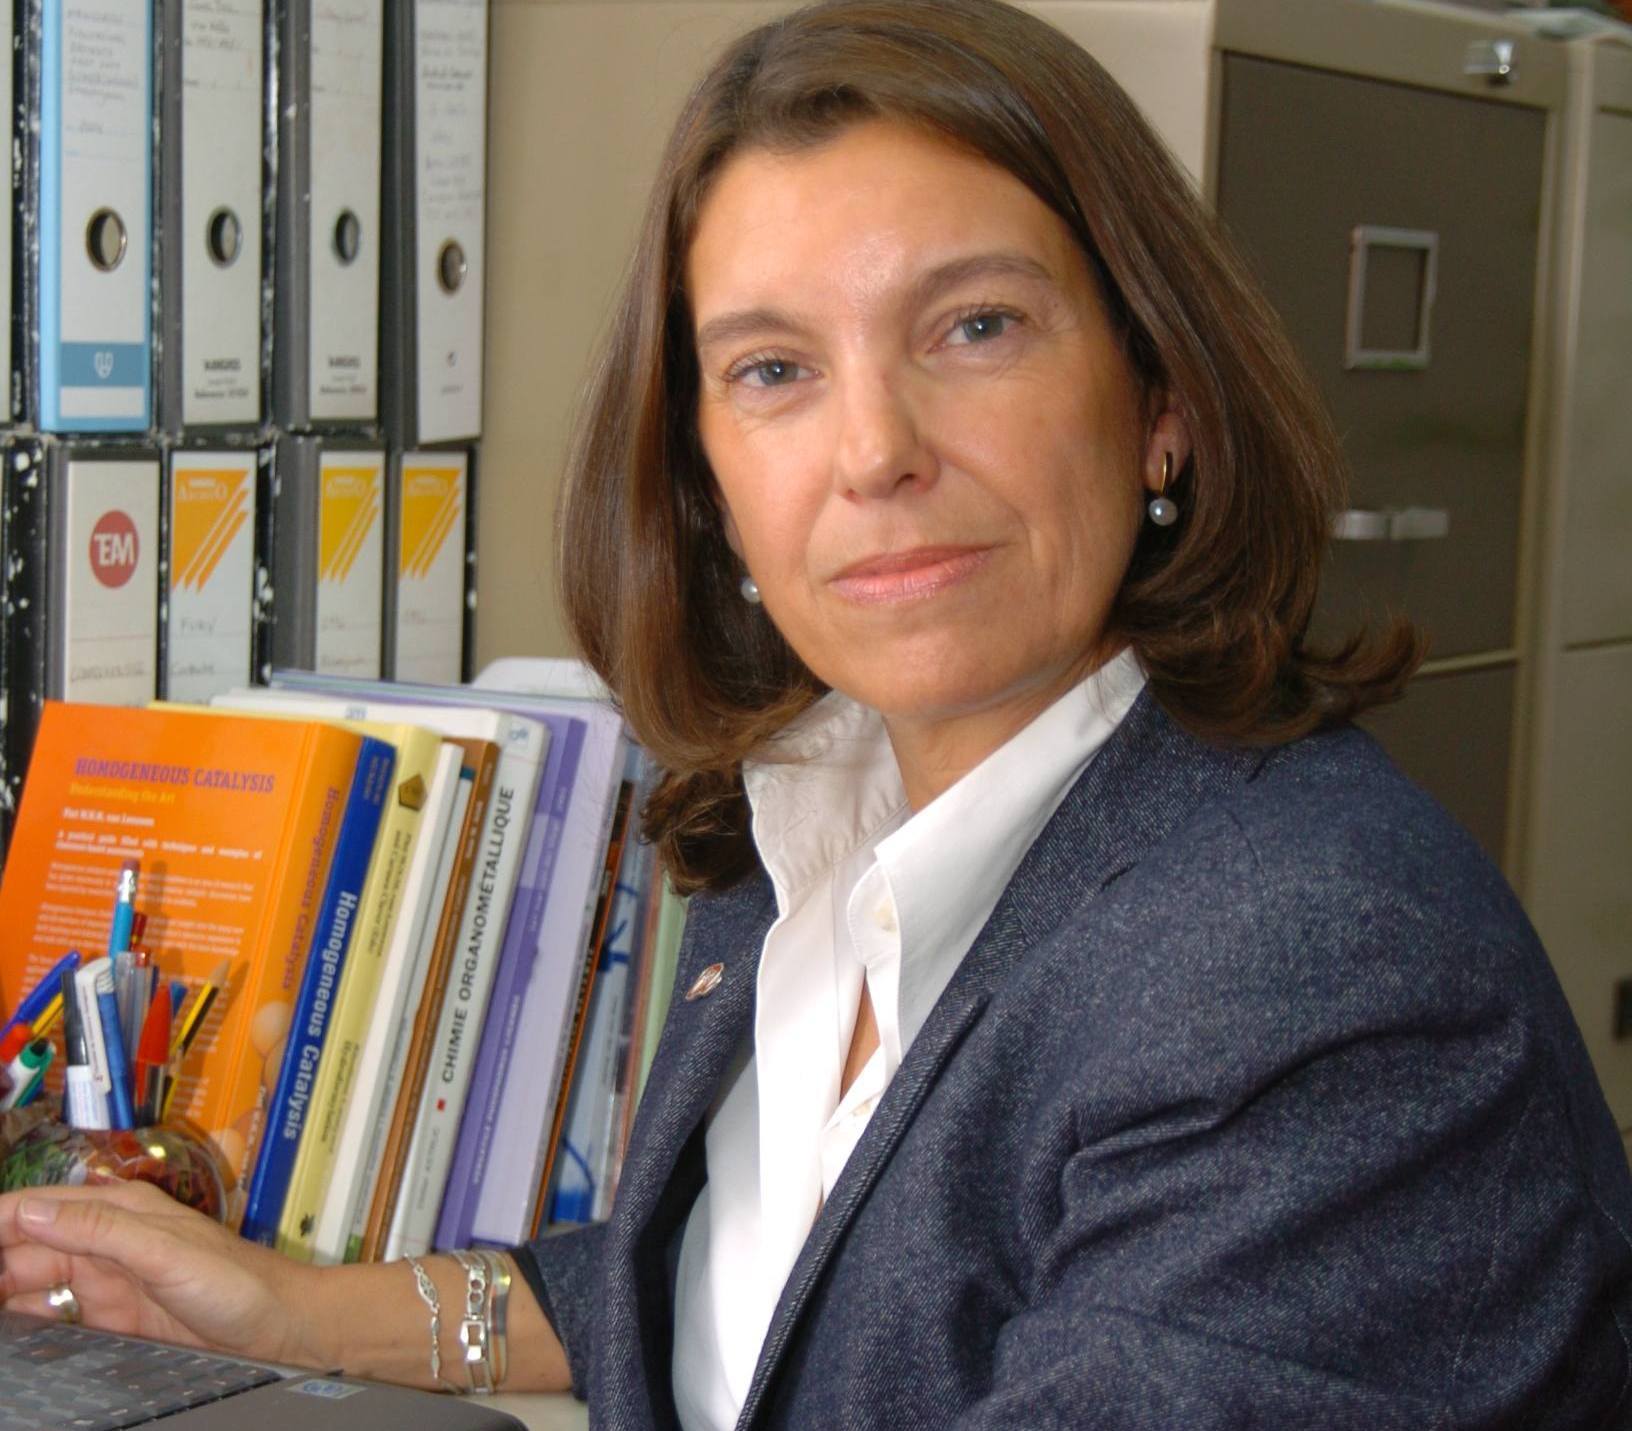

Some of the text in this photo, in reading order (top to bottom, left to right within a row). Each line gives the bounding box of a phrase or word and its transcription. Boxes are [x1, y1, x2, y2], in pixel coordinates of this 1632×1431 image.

[75, 757, 275, 793] HOMOGENEOUS CATALYSIS
[280, 786, 339, 991] Homogeneous Catalysis
[442, 1008, 468, 1083] CHIMIE
[458, 787, 514, 1001] ORGANOMÉTALLIQUE
[308, 891, 357, 1038] Homogeneous
[283, 1043, 321, 1141] Catalysis
